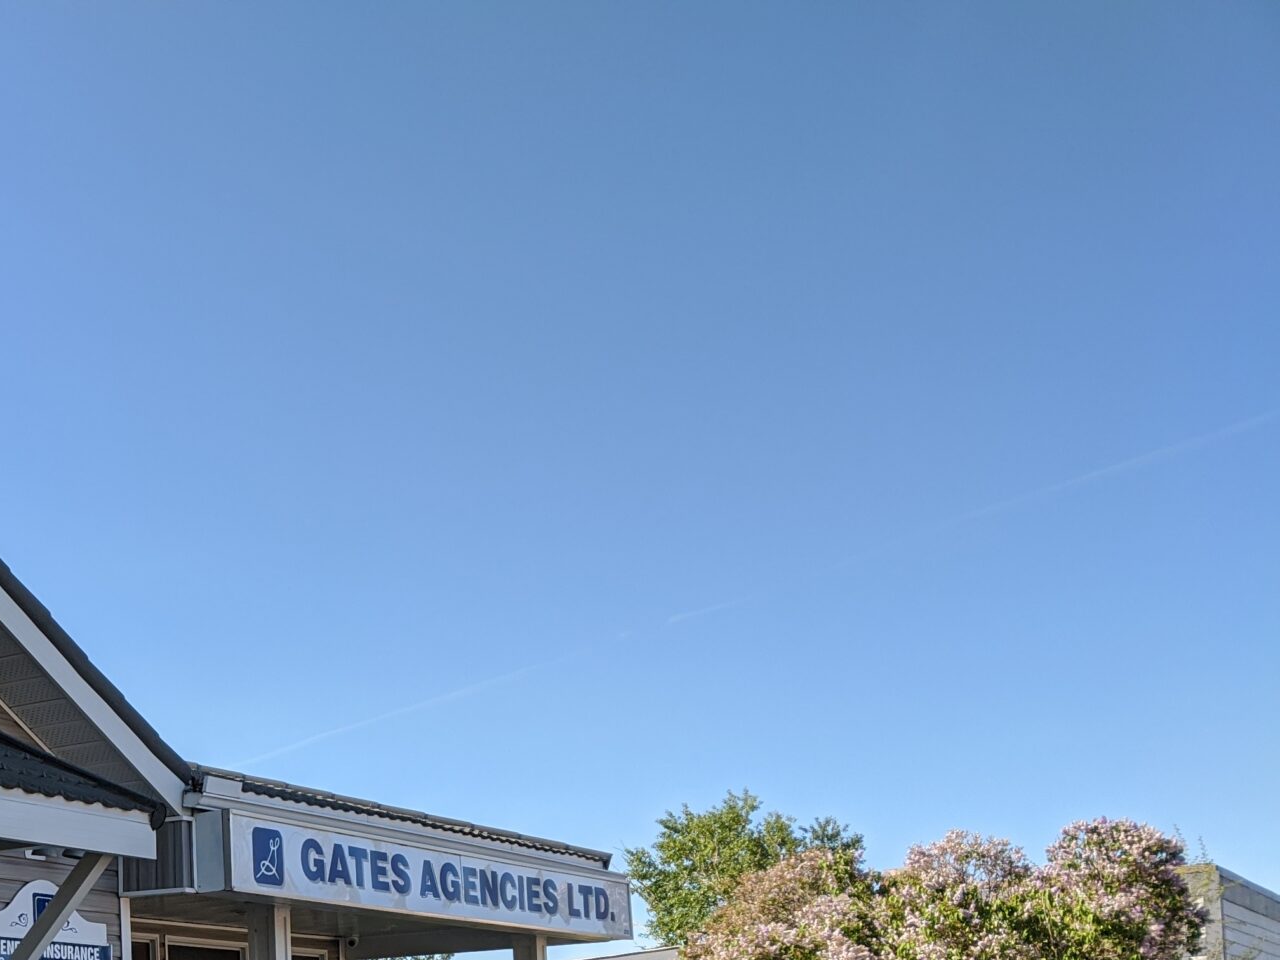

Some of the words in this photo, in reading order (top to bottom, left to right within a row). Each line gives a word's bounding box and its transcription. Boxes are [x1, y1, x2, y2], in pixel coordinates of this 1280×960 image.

[300, 837, 411, 894] GATES
[419, 859, 559, 915] AGENCIES
[567, 882, 616, 921] LTD.
